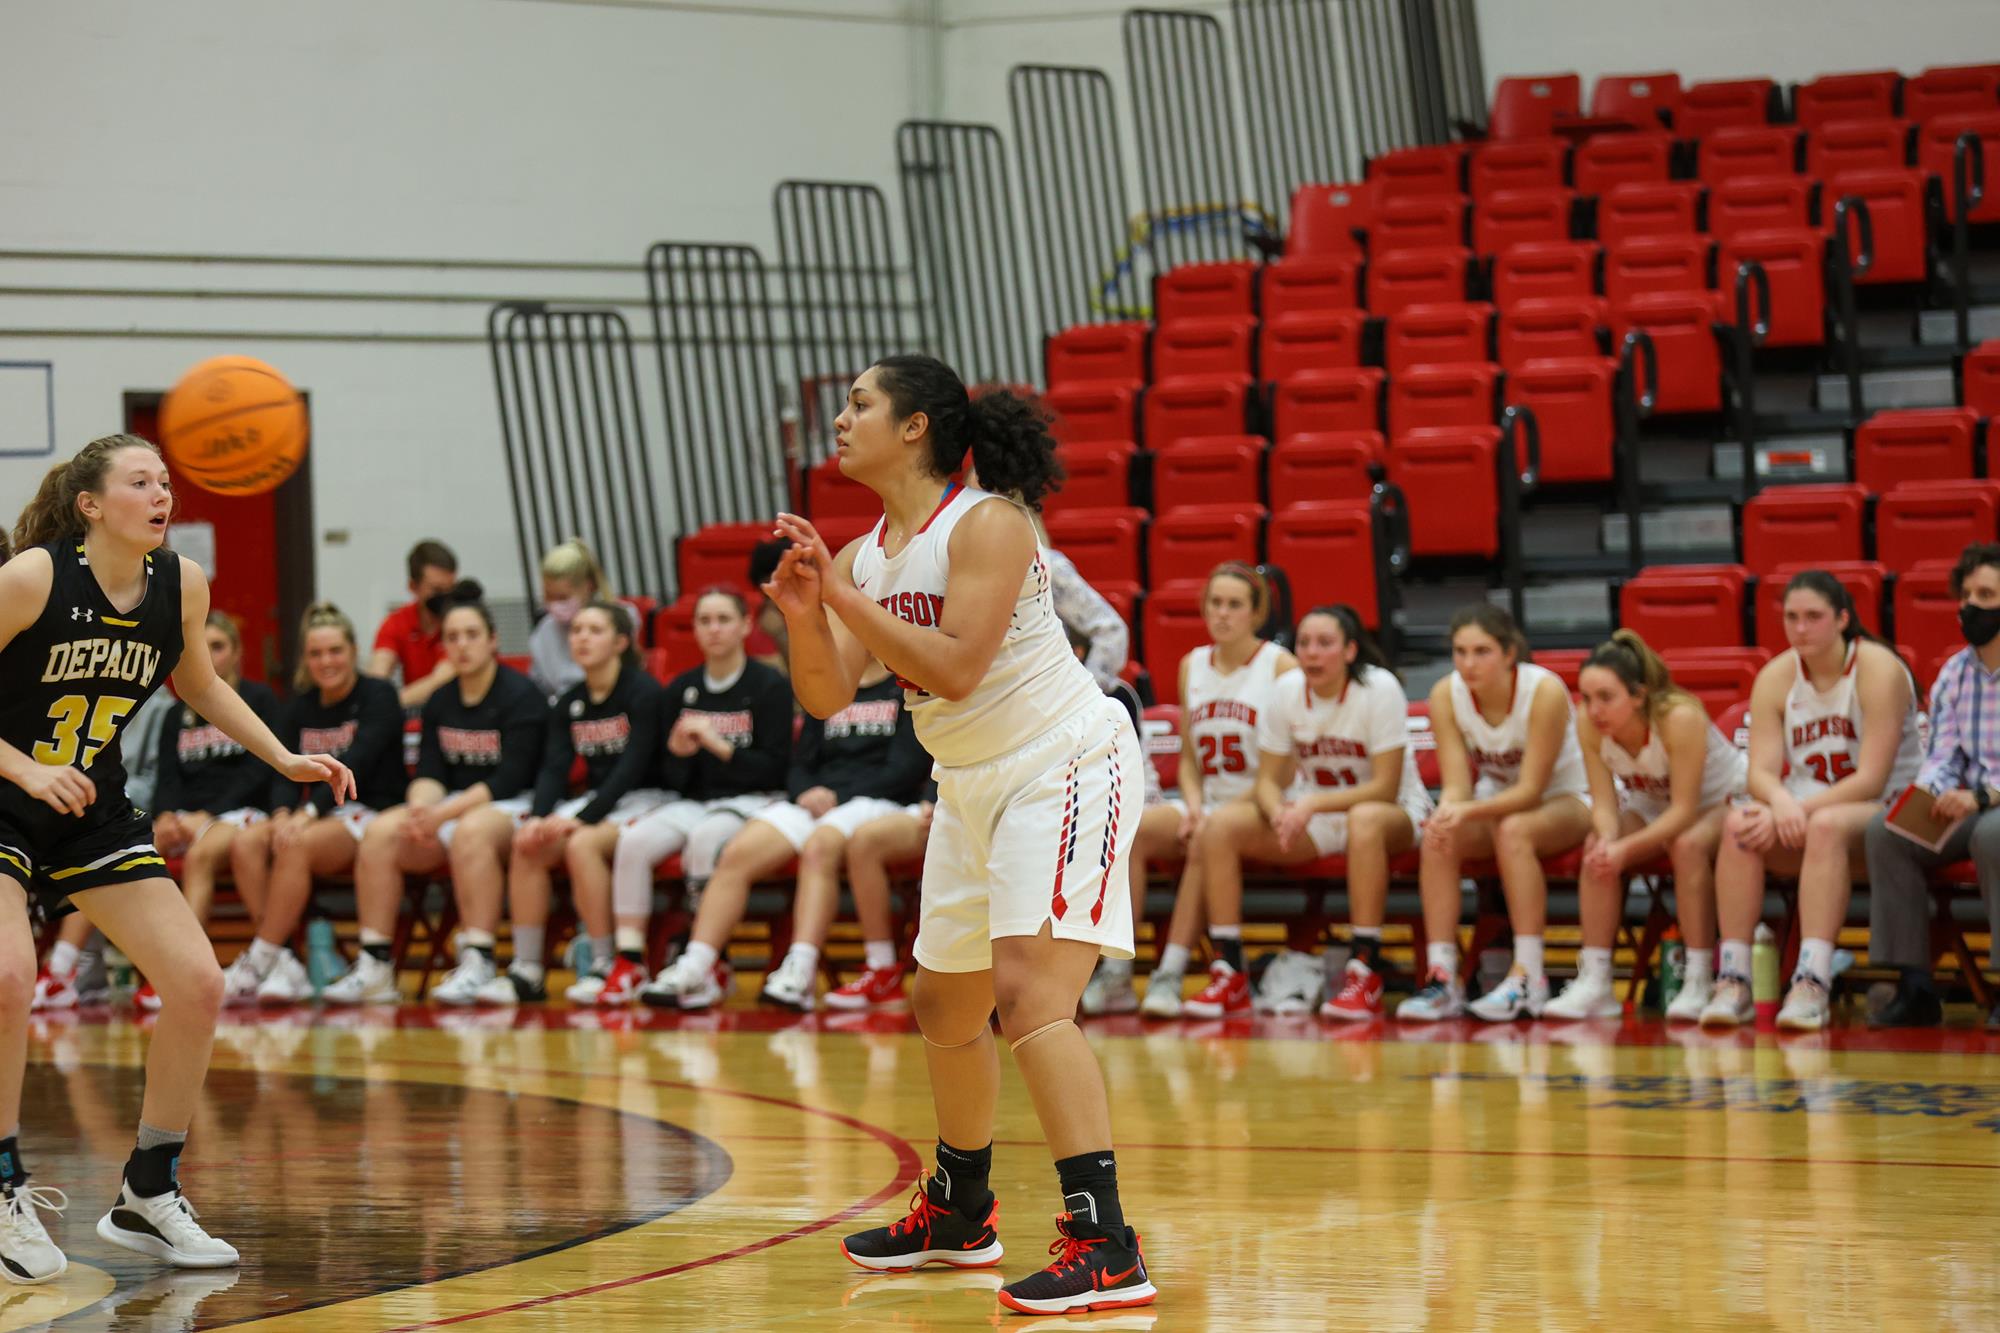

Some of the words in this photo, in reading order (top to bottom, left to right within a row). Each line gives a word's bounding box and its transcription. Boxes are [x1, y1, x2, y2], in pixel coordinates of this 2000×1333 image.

[876, 591, 945, 628] ISON
[40, 638, 161, 689] DEPAUW
[31, 694, 138, 772] 35
[1198, 735, 1246, 775] 25
